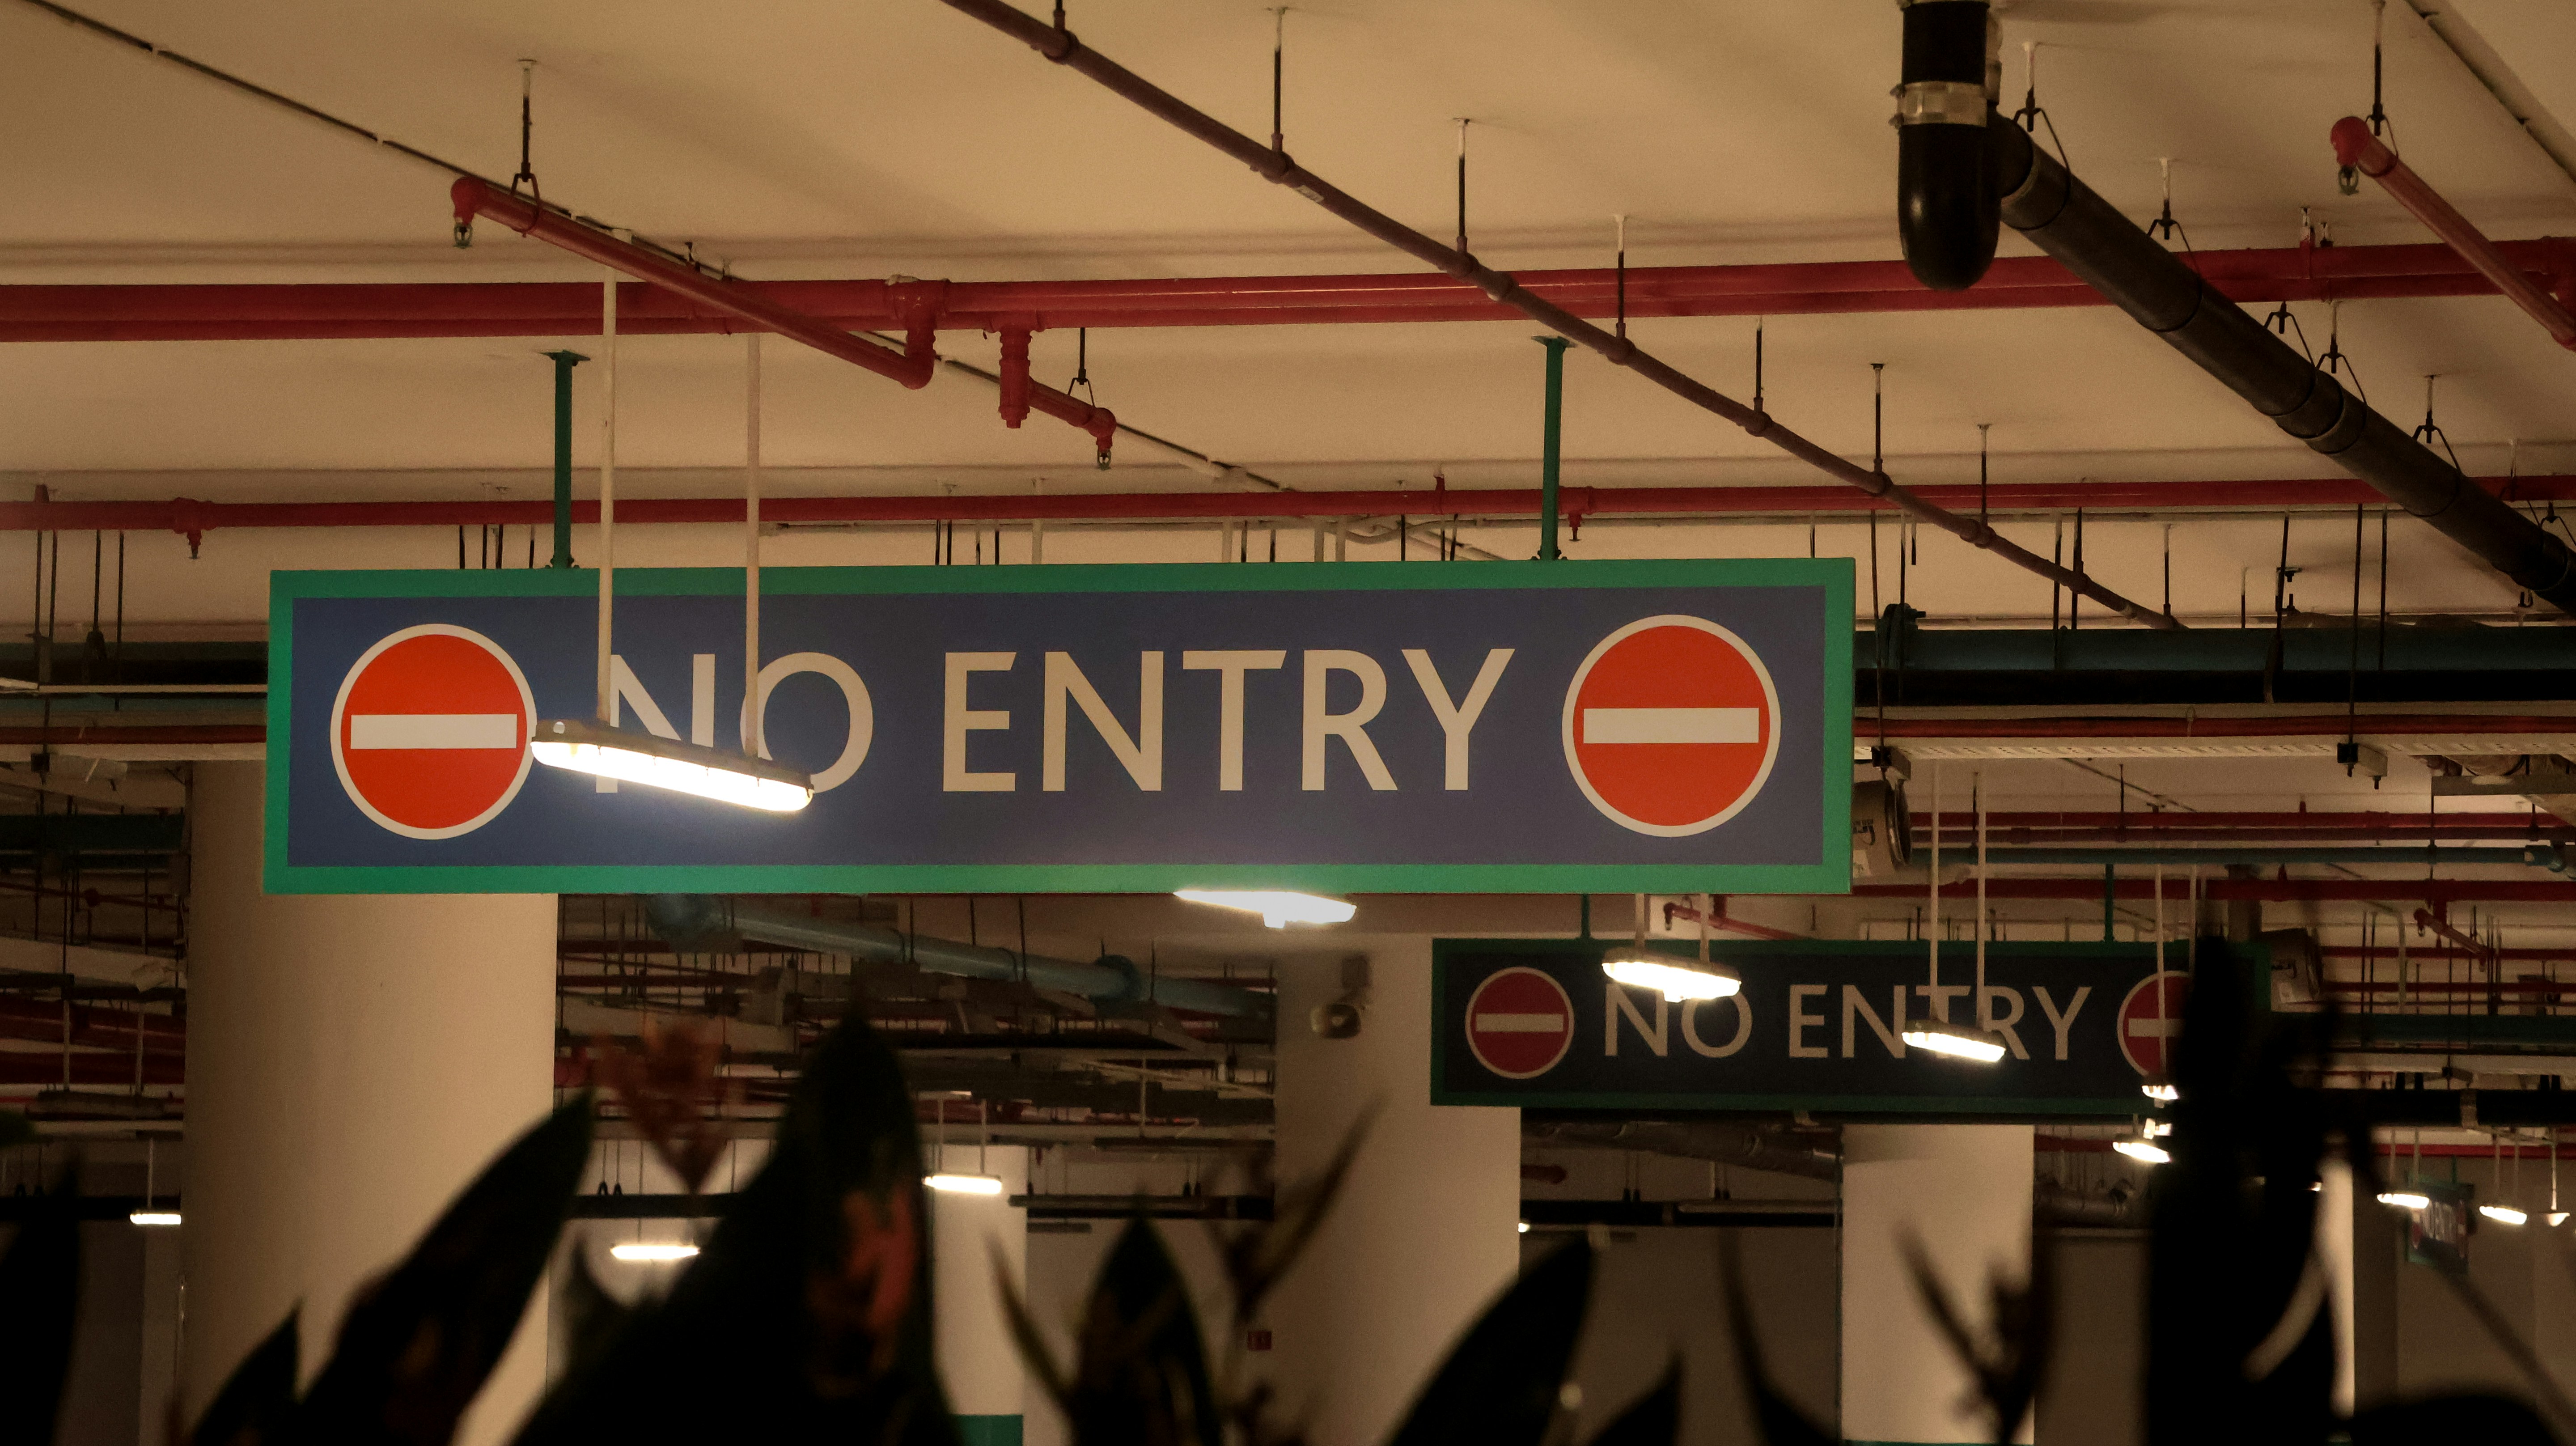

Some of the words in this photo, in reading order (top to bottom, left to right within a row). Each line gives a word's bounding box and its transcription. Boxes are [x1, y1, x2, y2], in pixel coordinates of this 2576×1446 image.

[596, 652, 873, 794] NO
[943, 648, 1516, 792] ENTRY
[1604, 983, 1753, 1059] NO
[1788, 984, 2093, 1060] ENTRY
